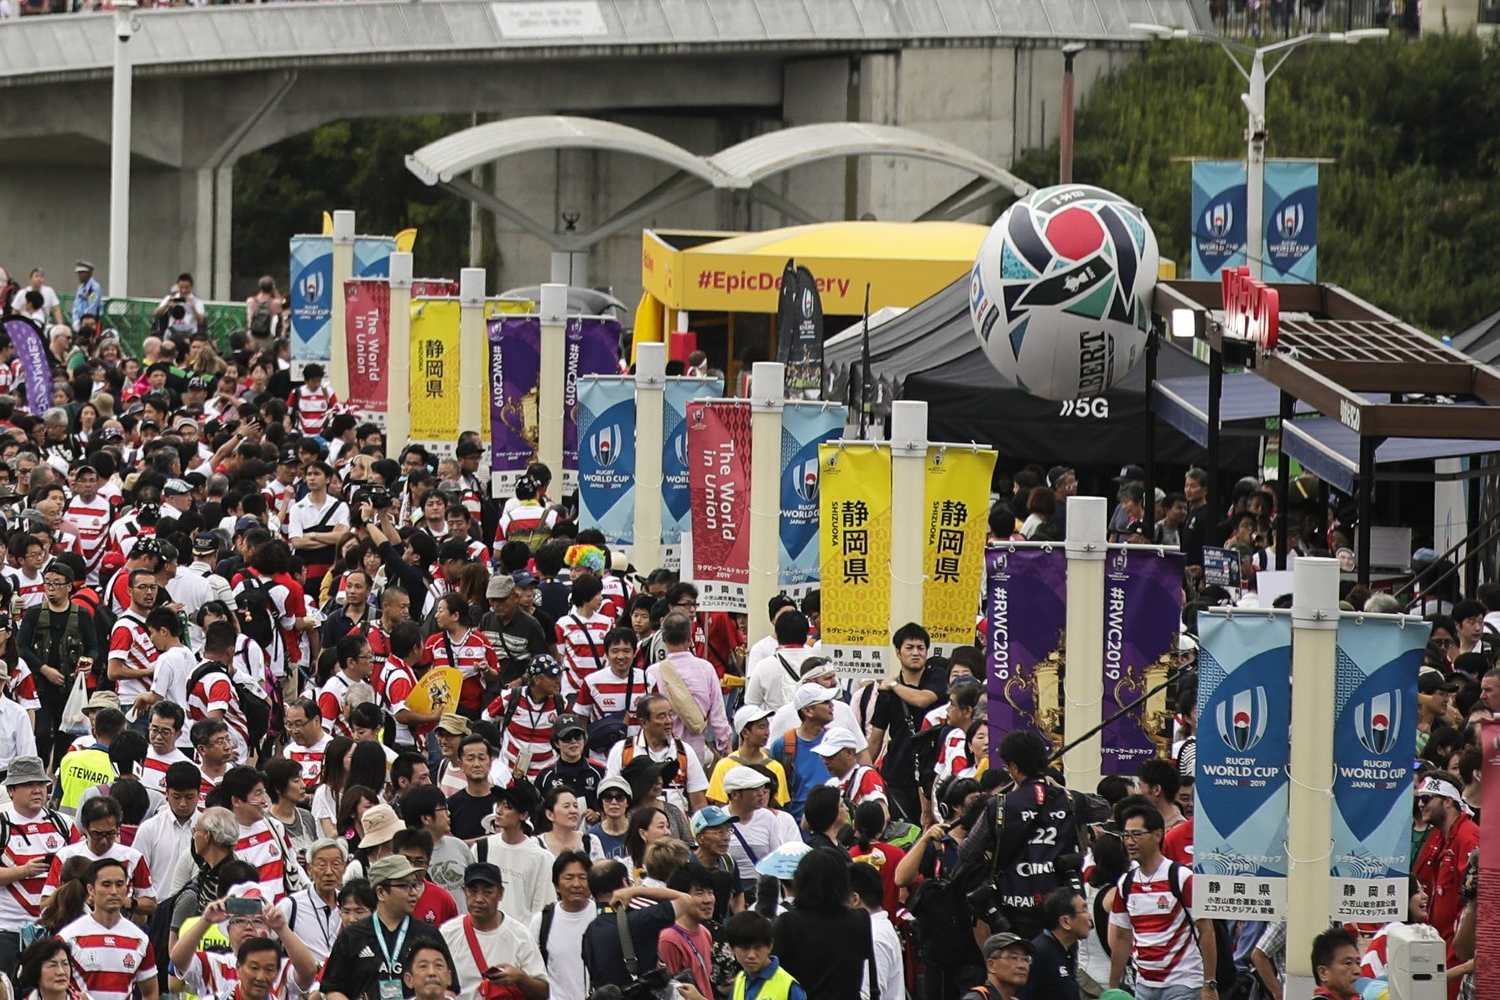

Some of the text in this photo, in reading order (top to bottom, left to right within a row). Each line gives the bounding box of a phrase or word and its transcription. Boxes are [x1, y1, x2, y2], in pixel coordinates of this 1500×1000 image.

[355, 315, 366, 374] in Union
[368, 308, 380, 382] The World
[425, 339, 444, 399] 静岡県
[565, 343, 579, 406] #RWC2019
[492, 345, 504, 408] #RWC2019
[583, 474, 630, 483] WORLD CUP
[666, 475, 690, 484] WORL
[702, 449, 717, 530] in Union
[719, 439, 736, 541] The World
[782, 509, 813, 519] WORLD
[831, 501, 839, 547] SHIZUOKA
[929, 501, 940, 546] SHIZUOKA
[841, 500, 870, 585] 静岡県
[933, 500, 968, 584] 静岡県
[826, 626, 888, 635] ラグビーワールドカップ
[993, 586, 1009, 681] #RWC2019
[1105, 586, 1125, 681] #RWC2019
[1225, 757, 1256, 766] RUGBY
[1363, 759, 1392, 769] RUGBY
[68, 766, 109, 785] STEWARD
[1203, 765, 1279, 778] WORLD CUP
[1340, 767, 1407, 780] WORLD CUP
[1213, 779, 1238, 787] JAPAN
[1249, 779, 1267, 788] 2019
[1351, 781, 1397, 790] JAPAN 2019
[1208, 881, 1271, 896] 静岡県
[1343, 884, 1396, 898] 静岡県
[1207, 897, 1272, 907] 小笠山総合運動公園
[1203, 904, 1258, 915] エコパスタジアム
[1337, 907, 1386, 916] エコパスタジアム
[379, 961, 403, 974] AG
